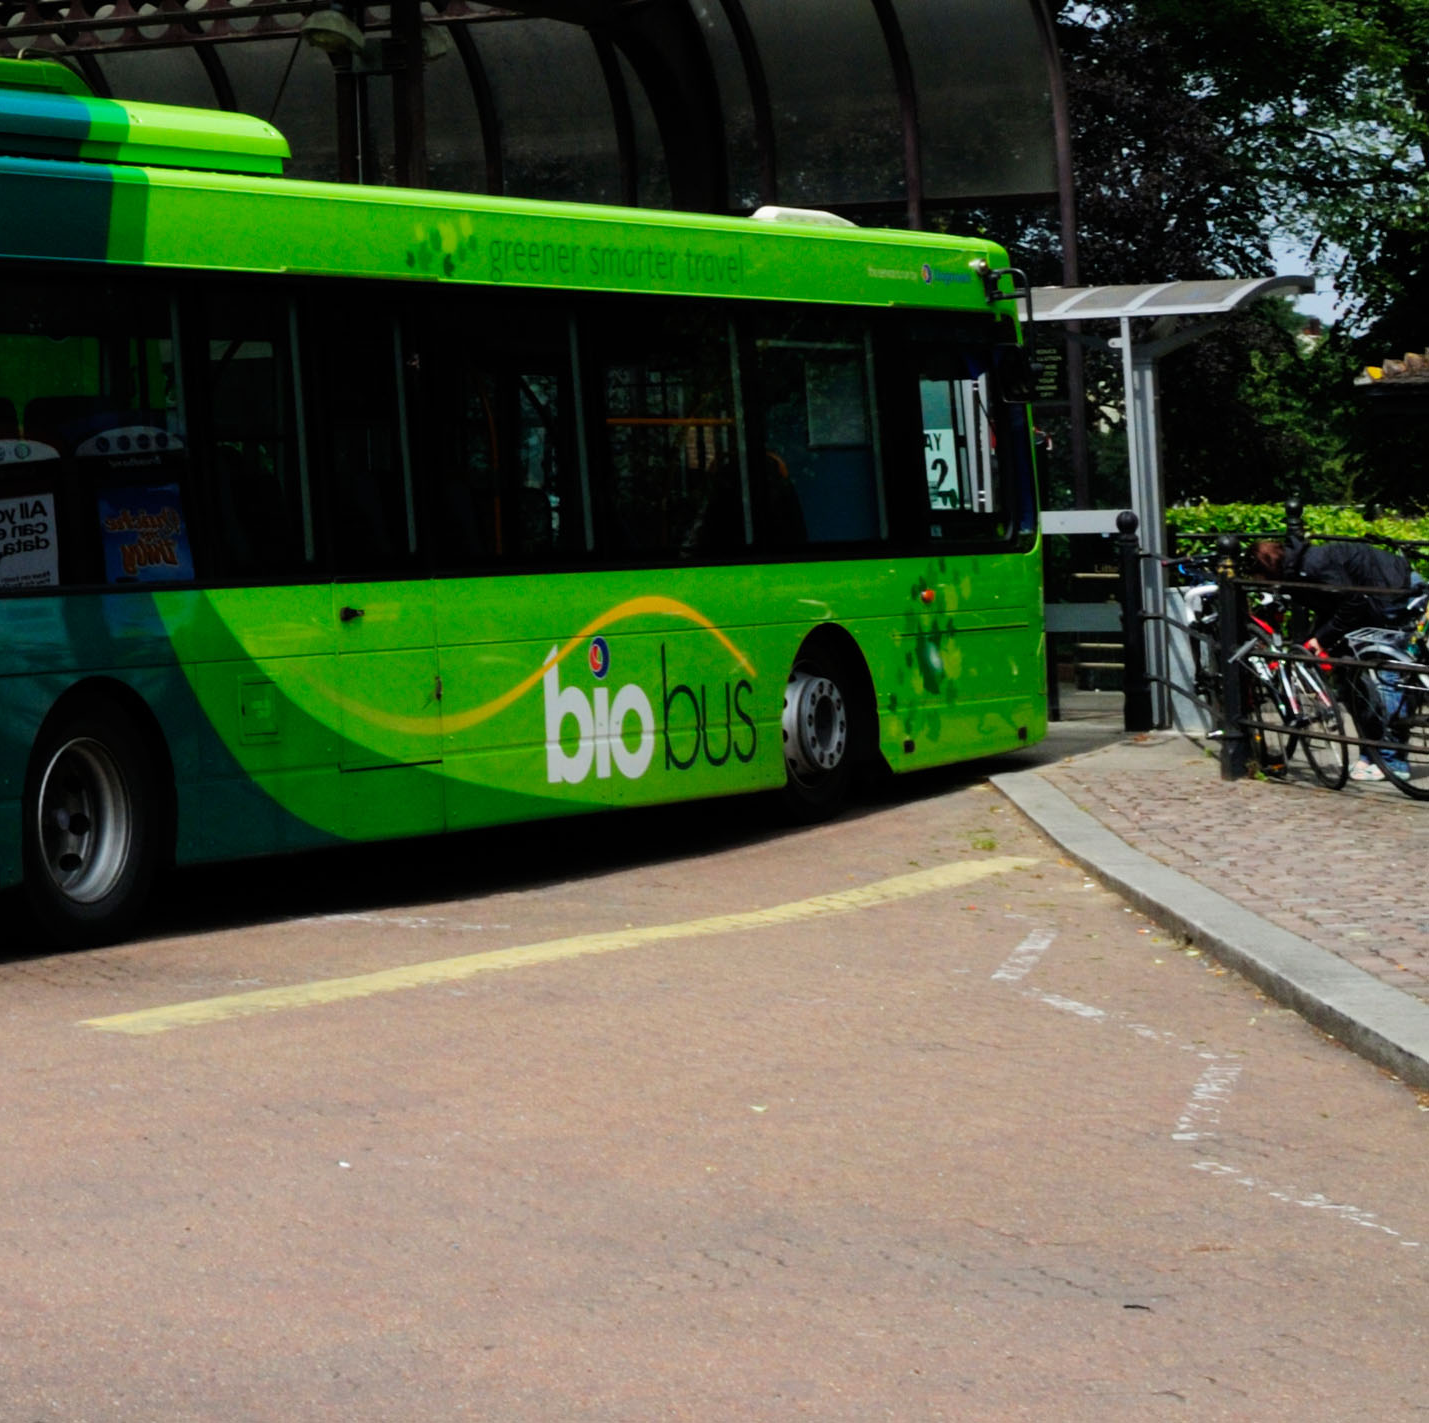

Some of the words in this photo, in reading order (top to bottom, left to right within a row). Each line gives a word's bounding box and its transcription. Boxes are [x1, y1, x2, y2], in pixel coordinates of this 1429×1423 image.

[491, 239, 581, 283] greener
[590, 241, 676, 278] smarter
[686, 243, 742, 284] travel
[543, 636, 655, 785] bio
[660, 641, 757, 771] bus
